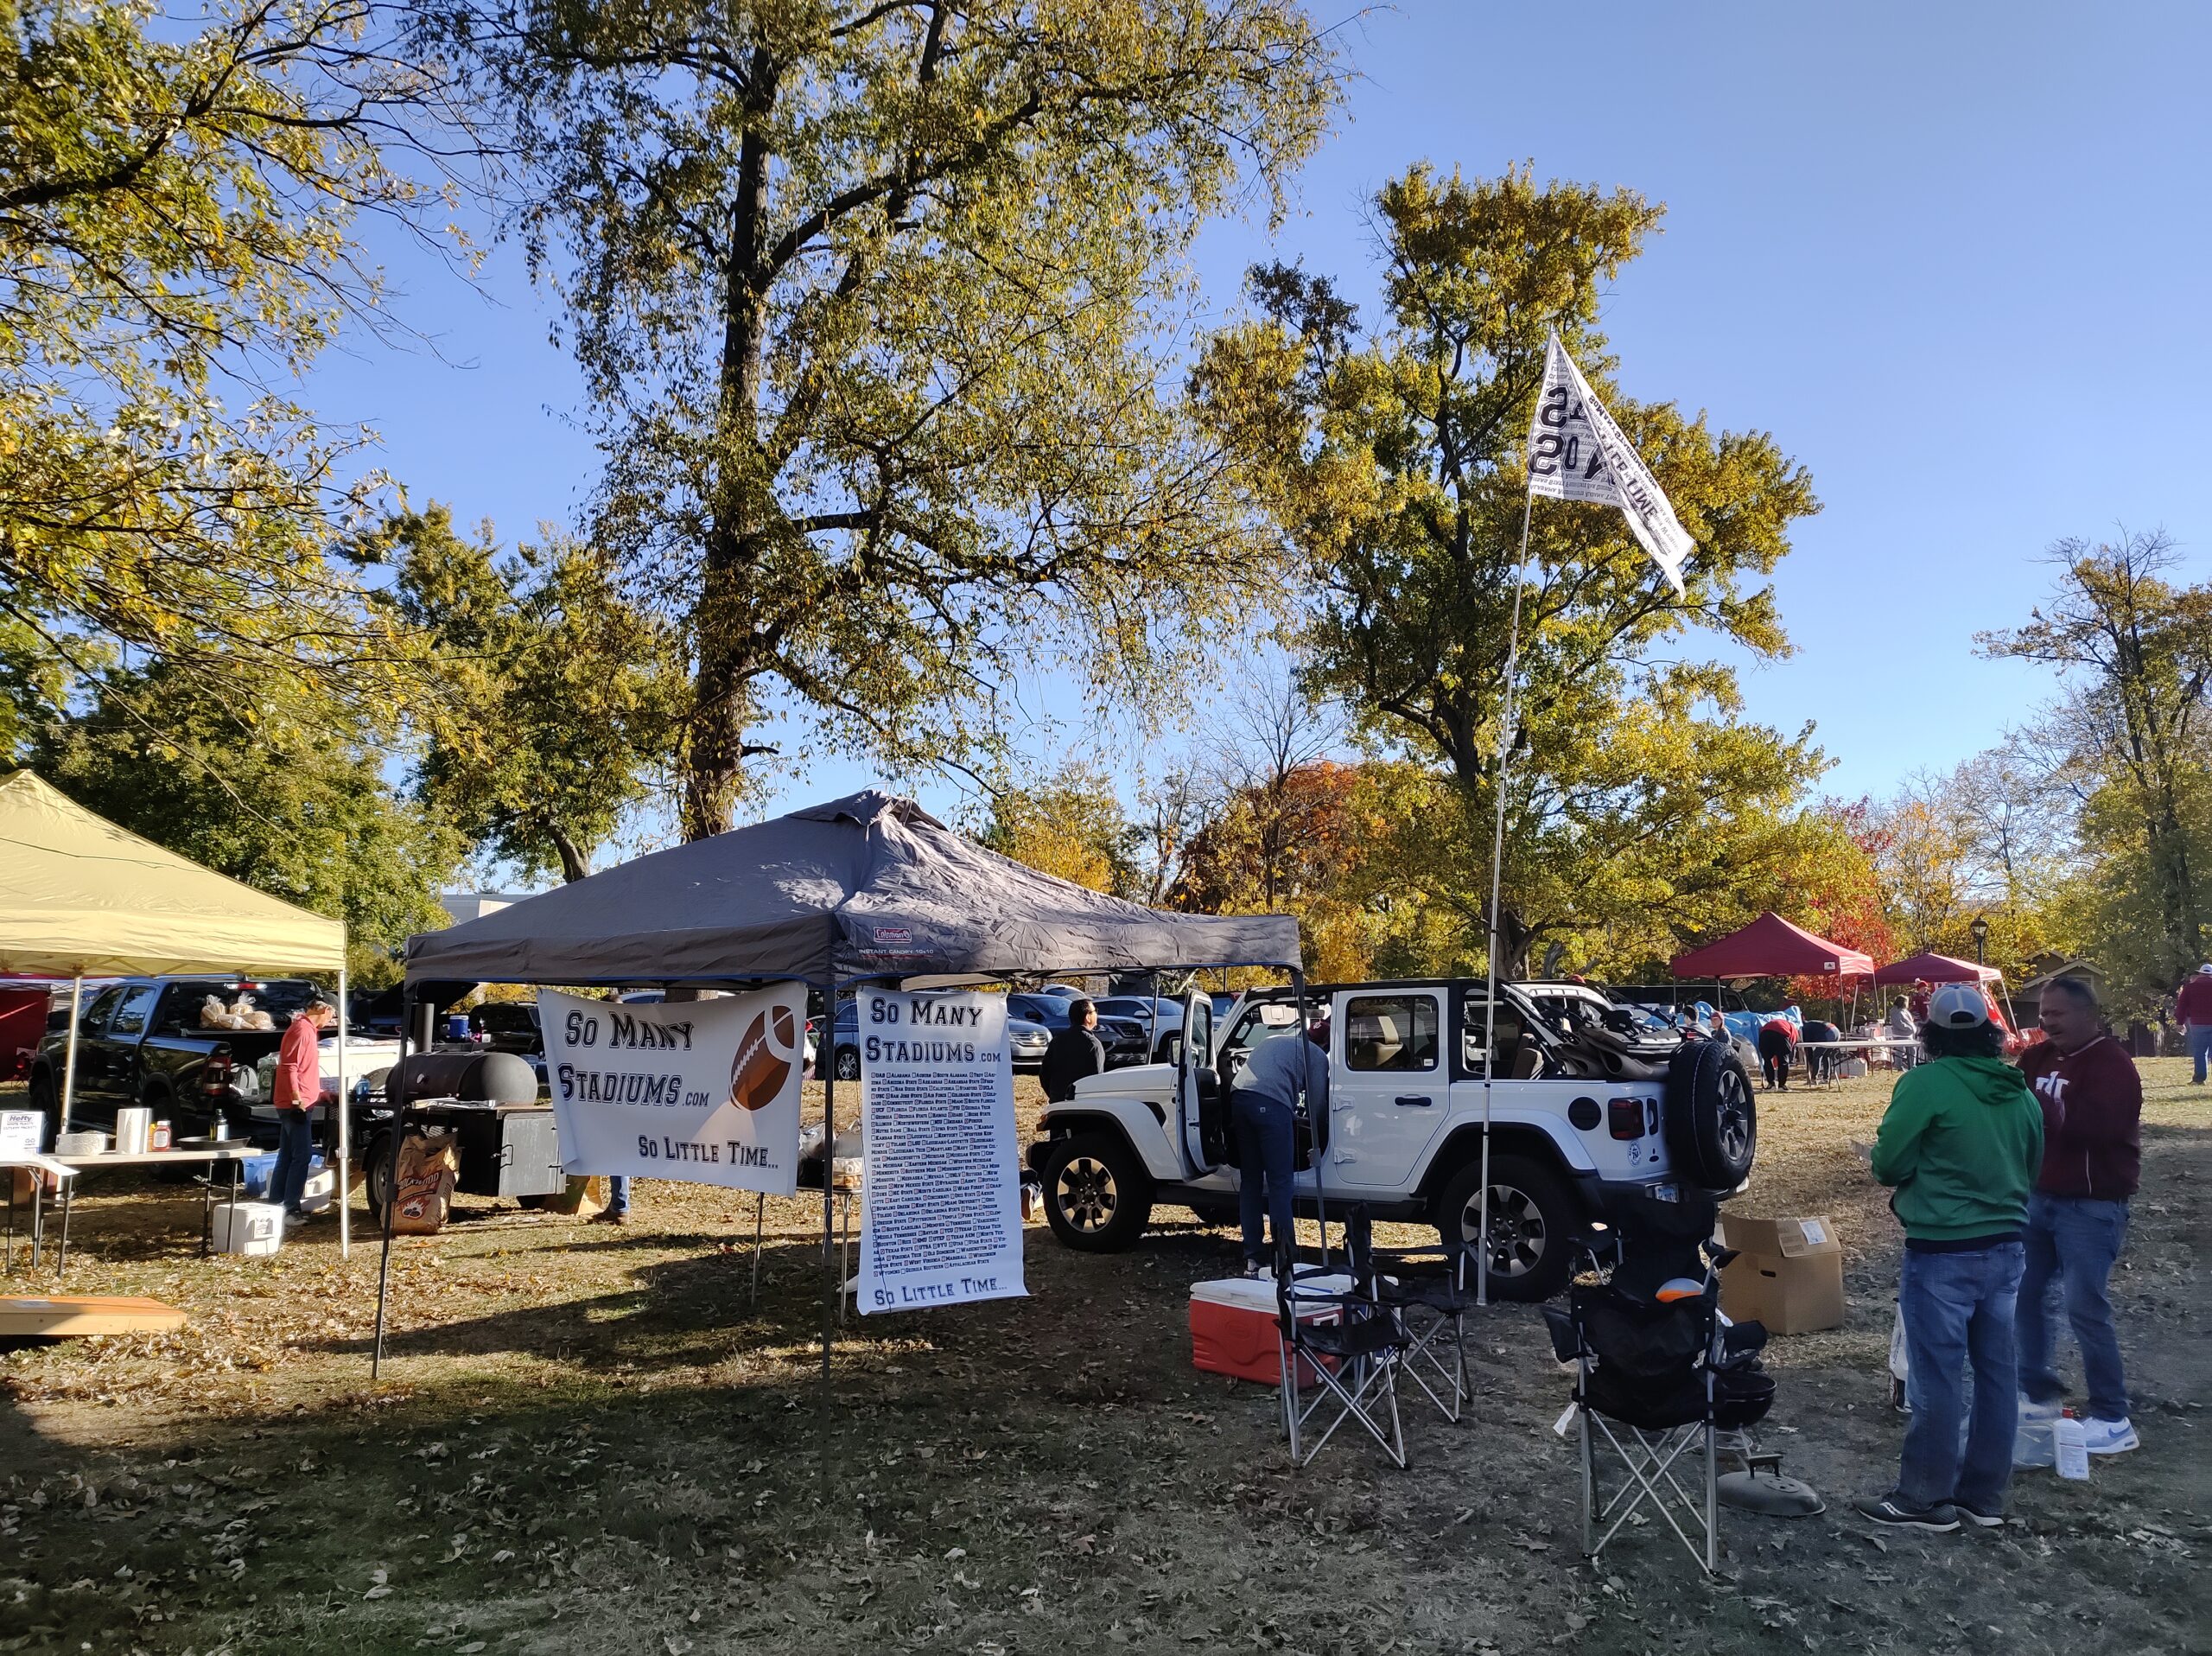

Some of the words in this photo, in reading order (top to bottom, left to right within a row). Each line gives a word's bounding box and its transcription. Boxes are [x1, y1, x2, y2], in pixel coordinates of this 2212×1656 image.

[876, 928, 905, 939] Coleman
[870, 997, 899, 1025] SO
[910, 999, 983, 1027] MANY
[565, 1010, 598, 1048] SO
[608, 1010, 695, 1051] MANY
[639, 1135, 658, 1158] SO
[664, 1137, 719, 1163] LITTLE
[874, 1289, 894, 1305] SO
[901, 1283, 954, 1303] LITTLE
